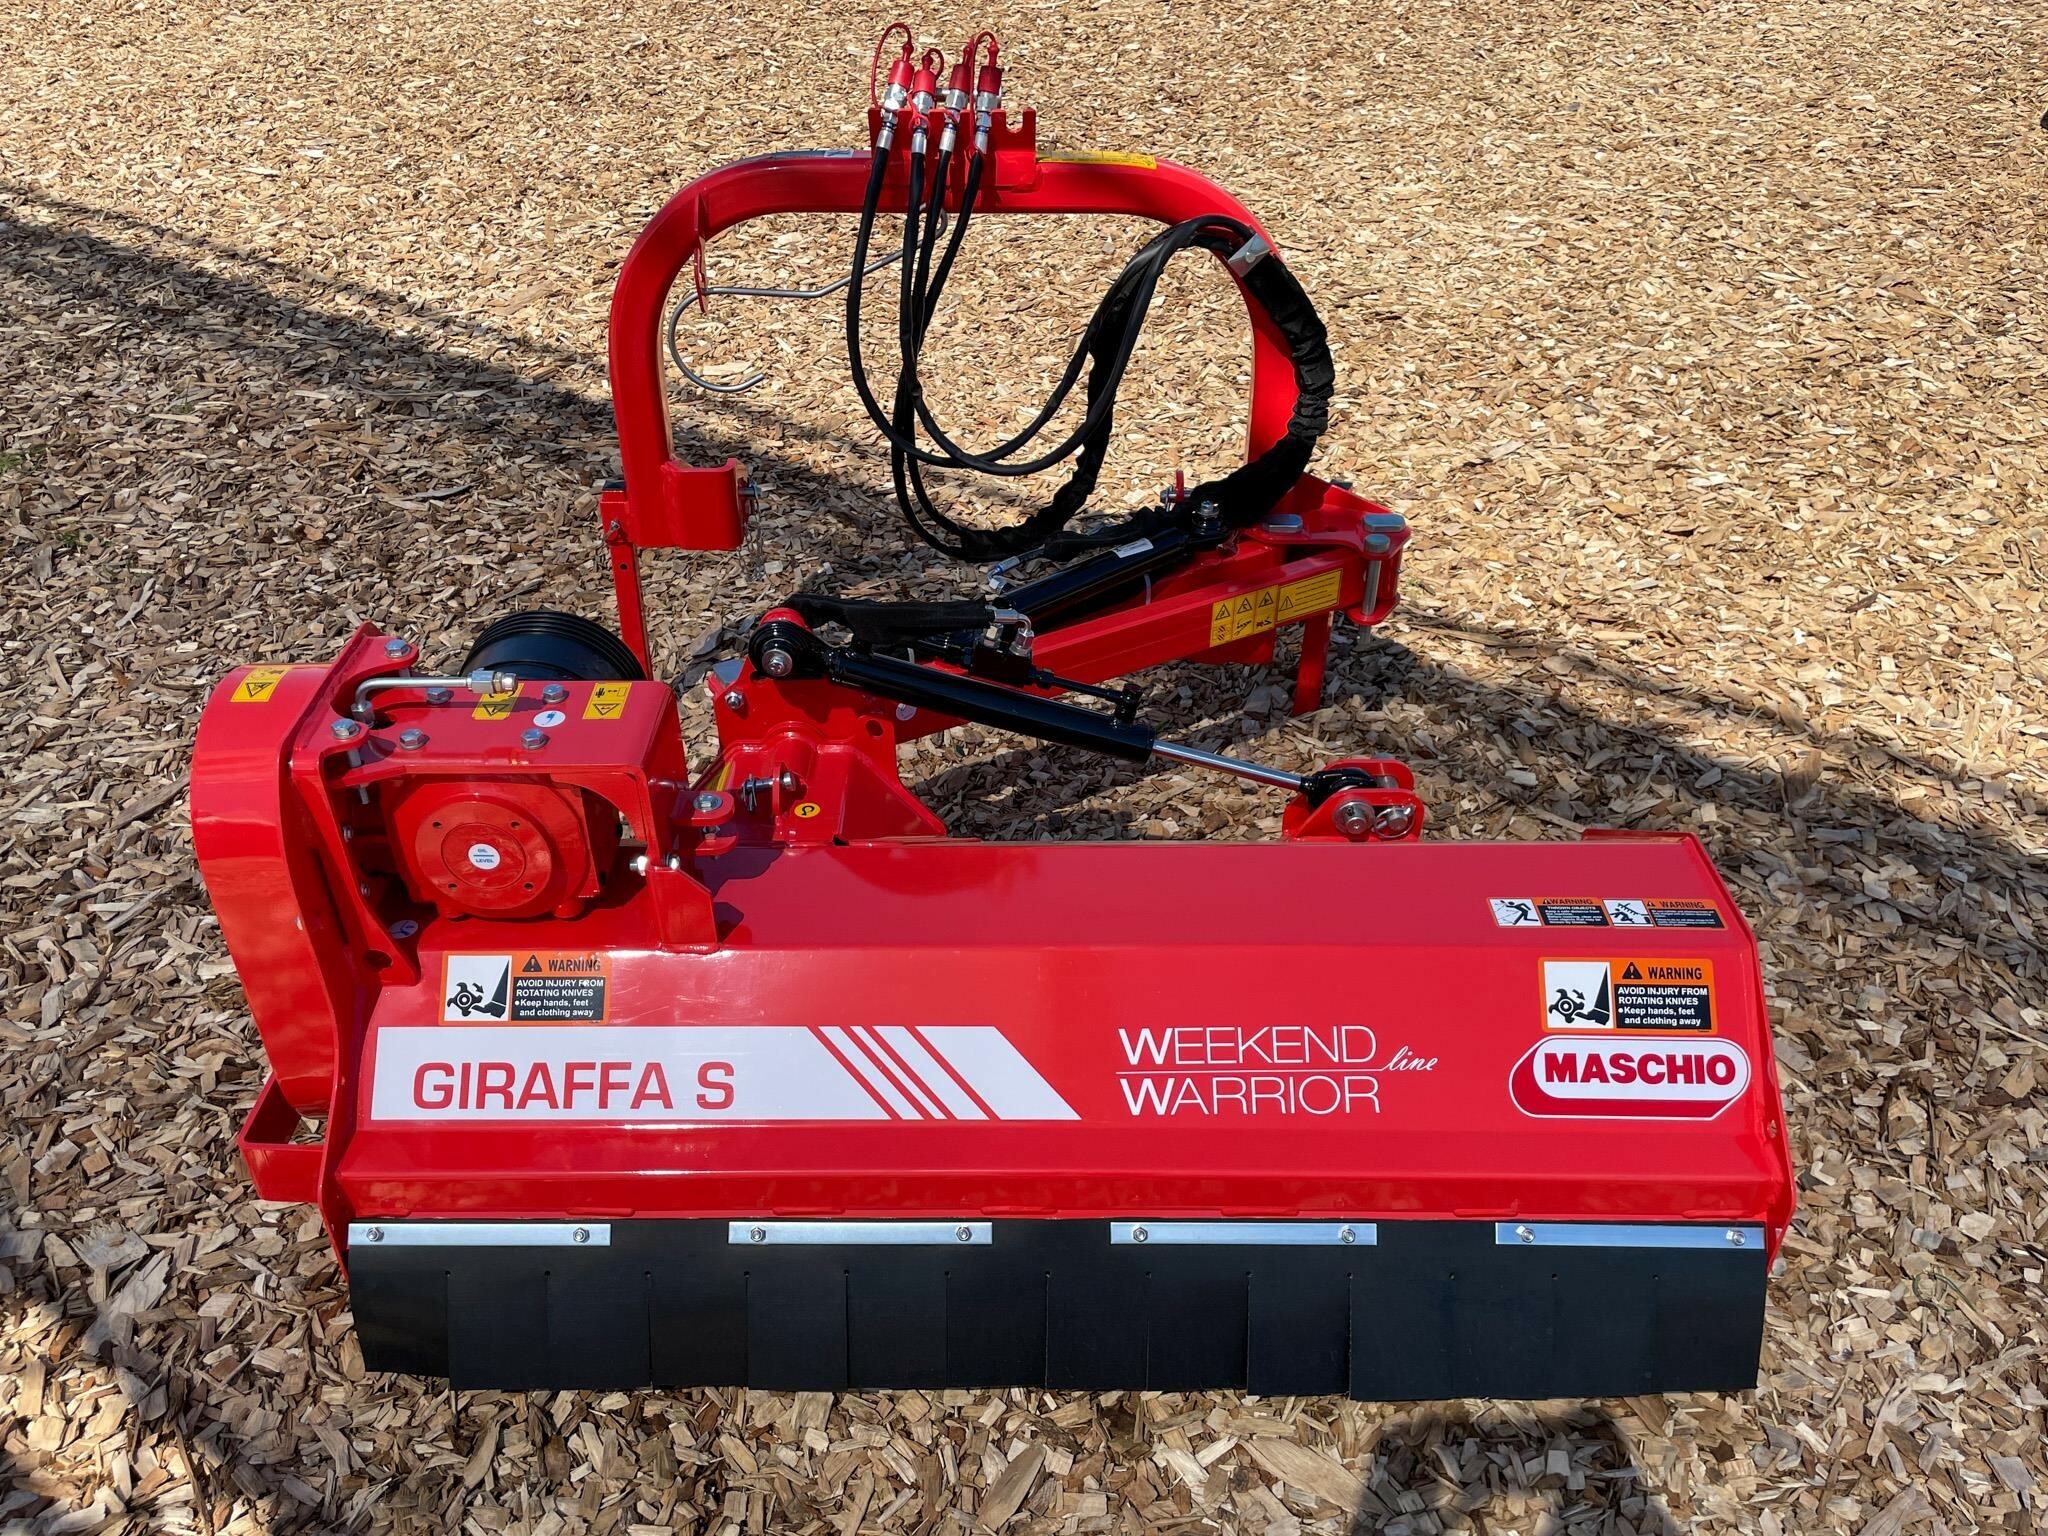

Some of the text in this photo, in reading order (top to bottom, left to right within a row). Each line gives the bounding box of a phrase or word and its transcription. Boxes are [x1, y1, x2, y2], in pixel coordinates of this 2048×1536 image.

[1659, 901, 1705, 909] WARNING
[548, 959, 601, 972] WARNING
[1648, 966, 1703, 980] WARNING
[516, 979, 604, 987] AVOID INJURY FROM
[516, 989, 594, 997] ROTATING KNIVES
[1617, 986, 1708, 996] AVOID INJURY FROM
[543, 999, 571, 1007] hands,
[573, 999, 589, 1007] feet
[1618, 996, 1699, 1006] ROTATING KNIVES
[537, 1009, 570, 1018] clothing
[572, 1010, 594, 1018] away
[1647, 1006, 1677, 1016] hands,
[1678, 1007, 1695, 1015] feet
[1624, 1016, 1701, 1026] and clothing away
[1118, 1025, 1438, 1072] WEEKEND line
[1544, 1052, 1737, 1086] MASCHIO
[412, 1061, 735, 1111] GIRAFFA S
[1119, 1075, 1381, 1116] WARRIOR
